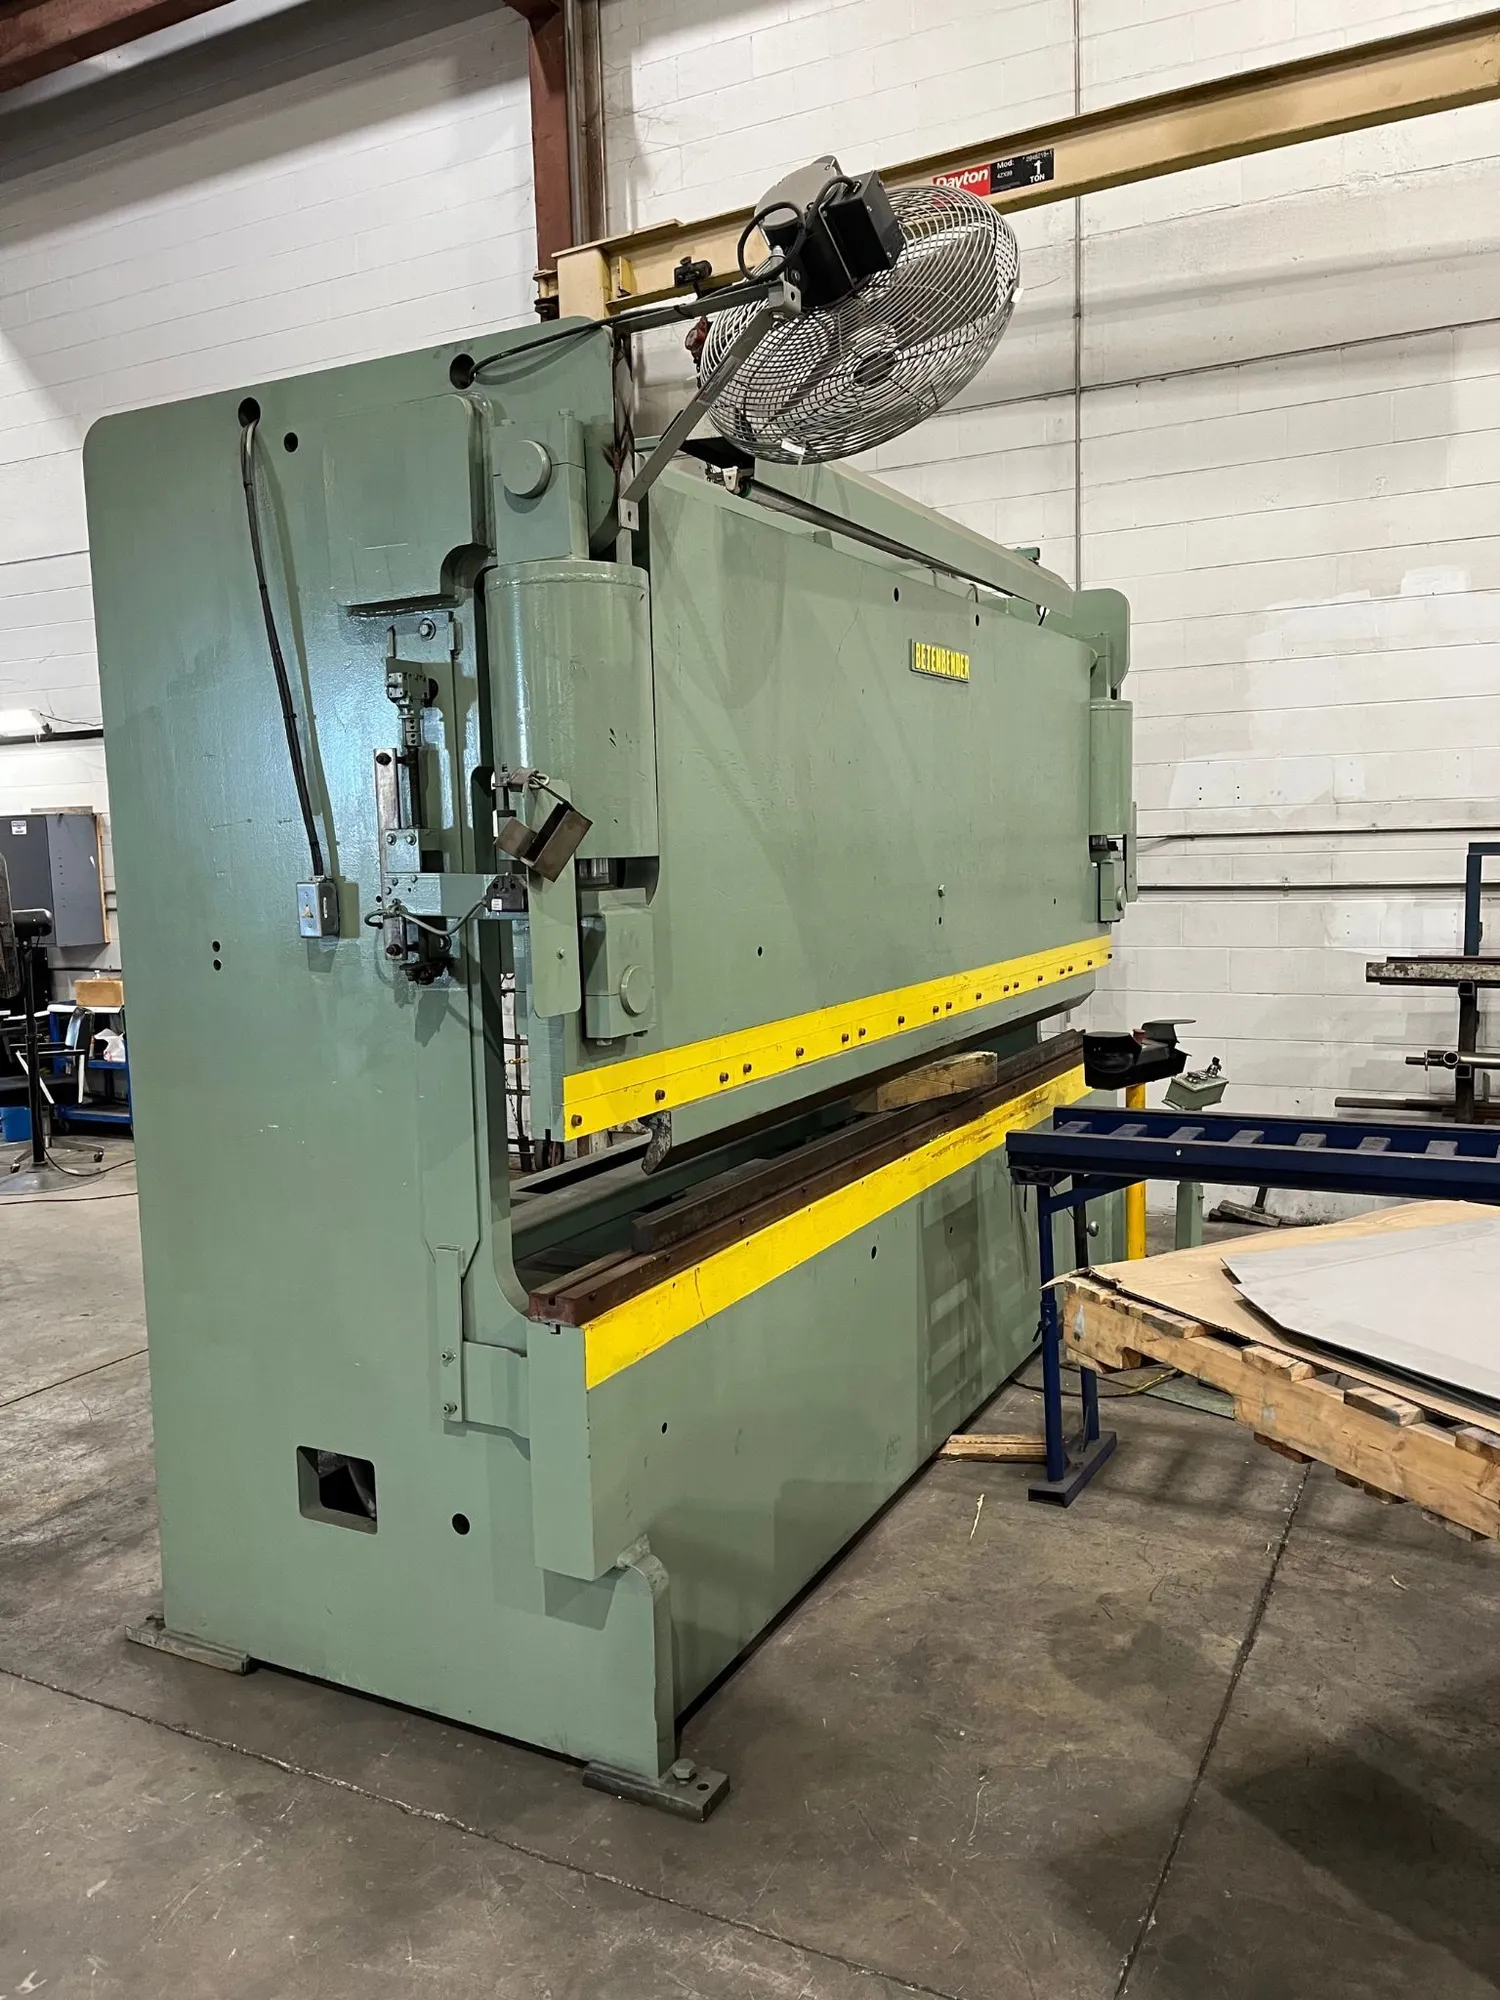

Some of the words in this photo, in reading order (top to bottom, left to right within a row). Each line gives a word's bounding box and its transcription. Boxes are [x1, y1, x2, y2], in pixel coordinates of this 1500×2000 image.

[997, 160, 1014, 169] Mod:
[1033, 160, 1043, 174] 1
[936, 168, 989, 188] Dayton
[1029, 173, 1045, 183] TON
[916, 642, 969, 680] BETENBENDER
